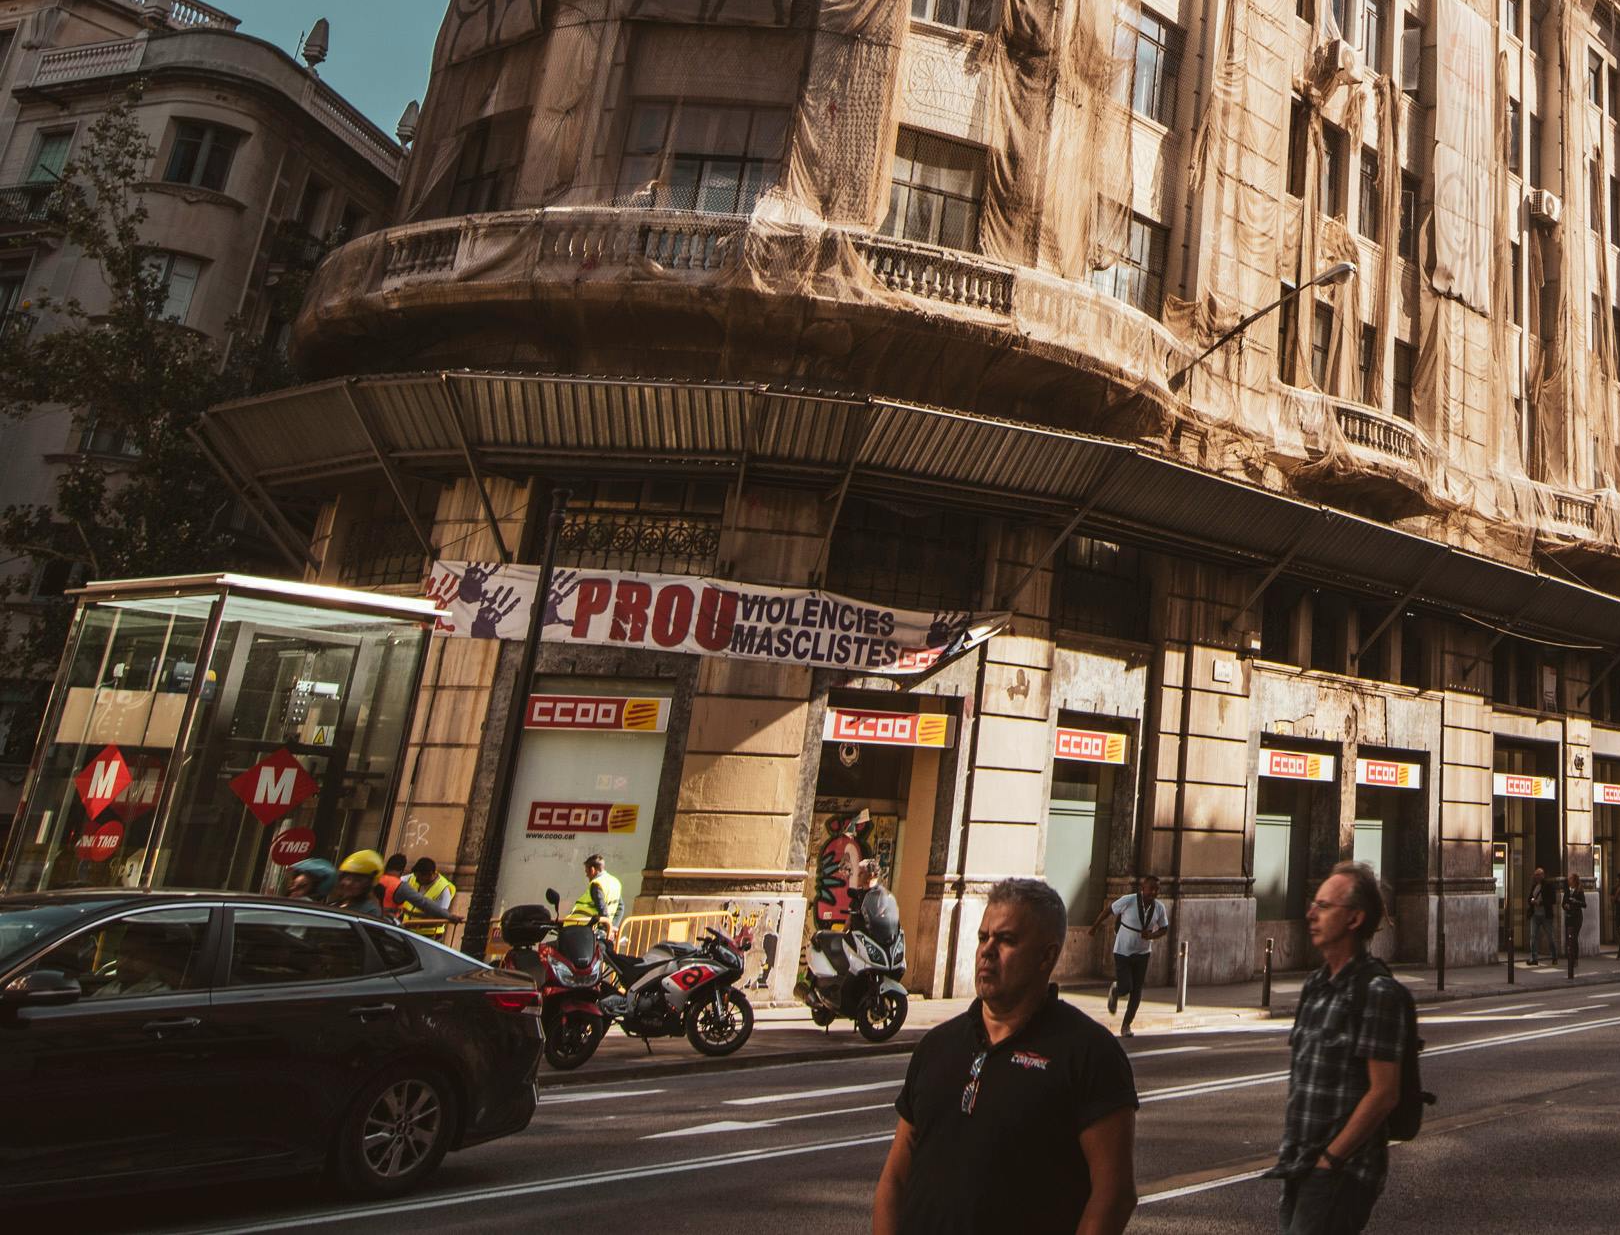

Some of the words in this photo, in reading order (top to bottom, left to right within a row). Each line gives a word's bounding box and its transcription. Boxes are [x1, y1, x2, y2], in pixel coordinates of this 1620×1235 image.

[571, 578, 739, 652] PROU
[740, 592, 895, 637] VIOLÈNCIES
[730, 623, 897, 667] MASCLISTES
[532, 701, 618, 724] CCOO
[839, 714, 911, 739] CCOO
[1058, 734, 1103, 755] CCOO
[1271, 755, 1304, 774] CCOO
[1367, 765, 1396, 782] CCOO
[87, 760, 121, 799] M
[253, 766, 298, 805] M
[1507, 778, 1532, 794] CCOO
[533, 807, 604, 827] CCOO
[97, 834, 119, 848] TMB
[278, 840, 311, 854] TMB
[525, 832, 576, 841] www.ccoo.cat
